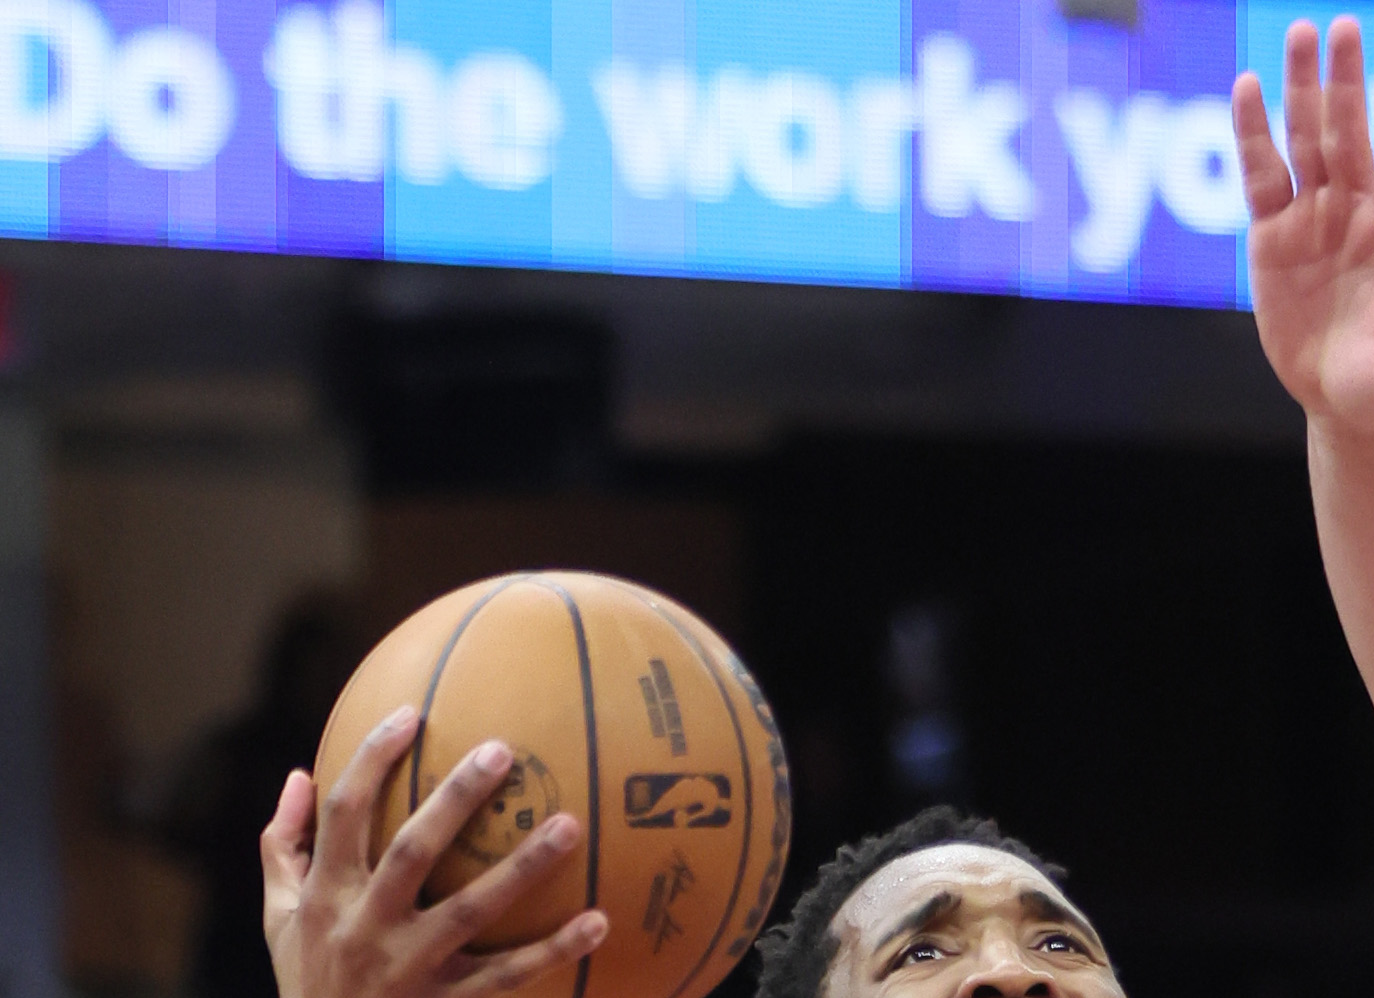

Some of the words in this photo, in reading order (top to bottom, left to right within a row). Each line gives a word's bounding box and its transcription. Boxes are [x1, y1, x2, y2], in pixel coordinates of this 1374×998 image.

[0, 0, 236, 171] Do
[263, 0, 564, 191] the
[590, 32, 1034, 222] work
